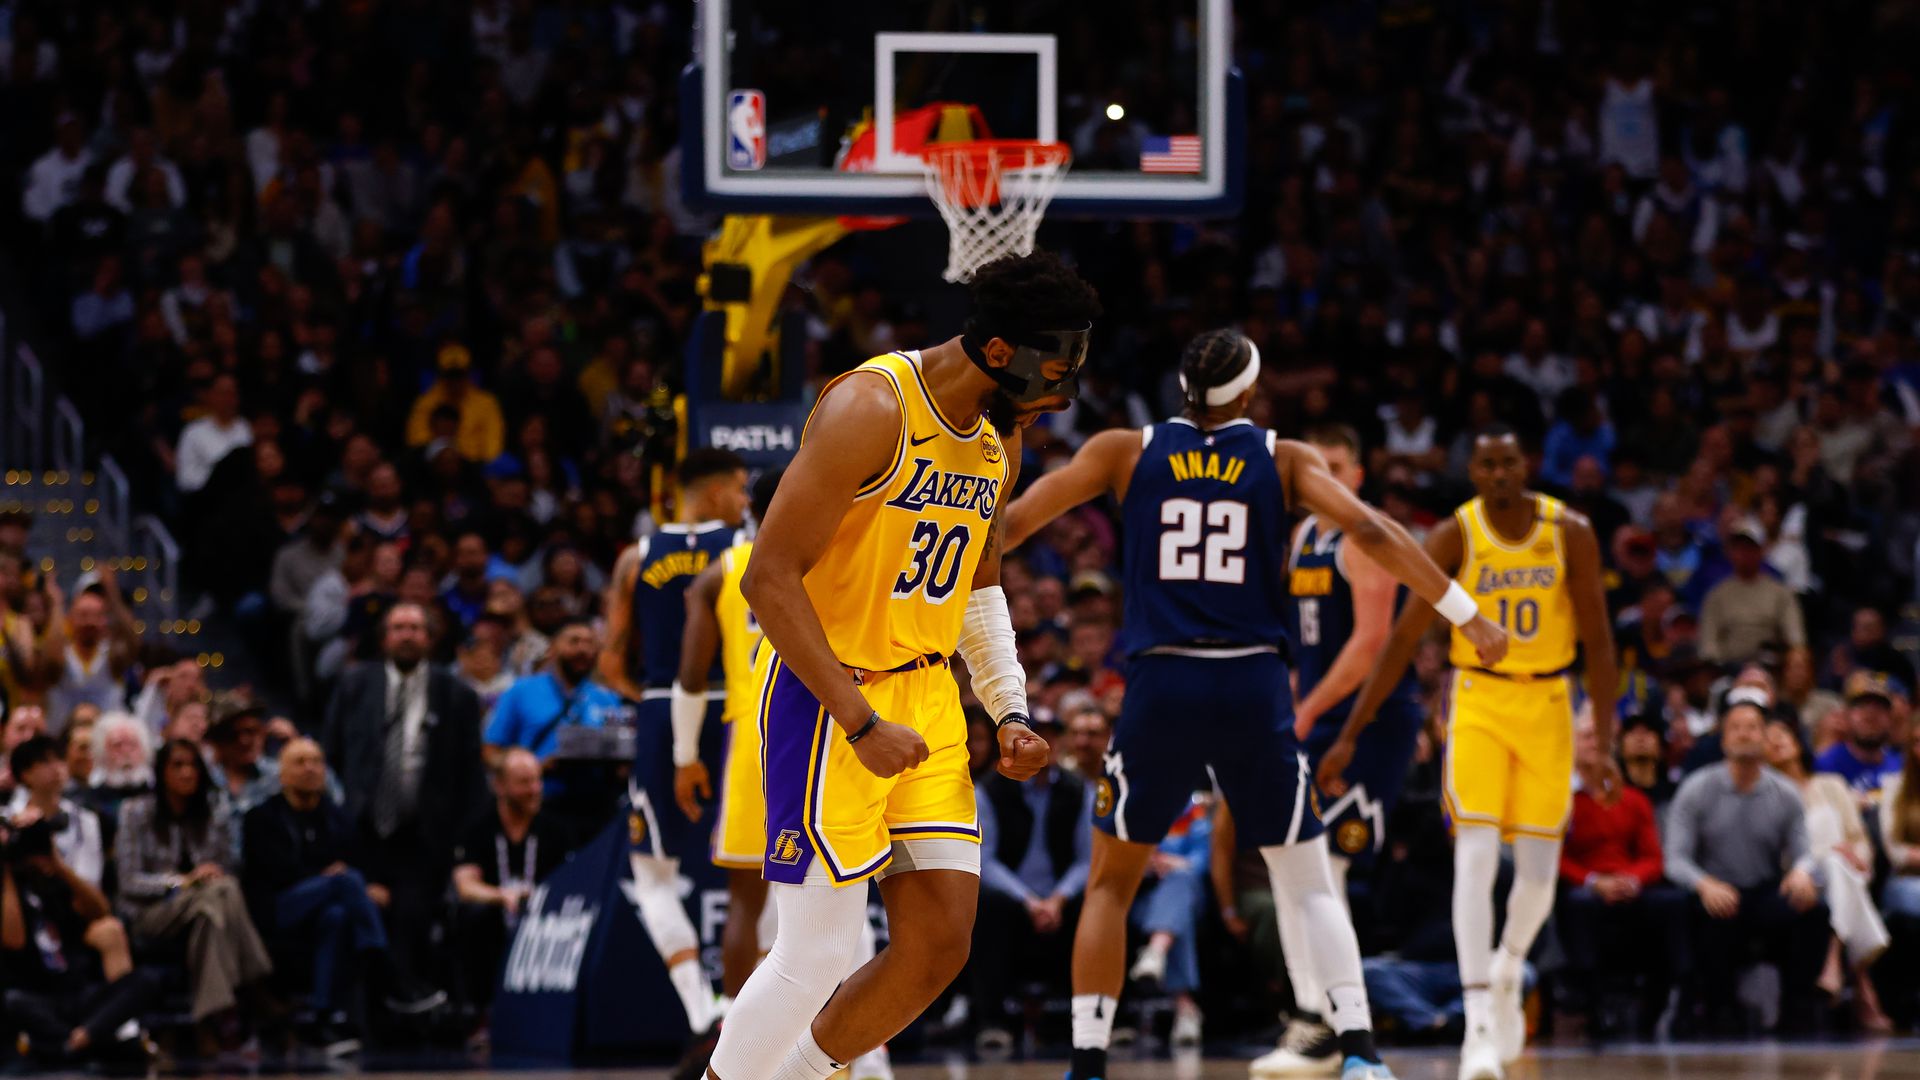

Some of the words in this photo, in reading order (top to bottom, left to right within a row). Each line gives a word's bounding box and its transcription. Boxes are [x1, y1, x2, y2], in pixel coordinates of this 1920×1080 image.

[710, 425, 794, 451] PATH
[885, 457, 999, 520] LAKERS
[1168, 450, 1246, 485] NNAJI
[891, 519, 971, 605] 30
[1159, 497, 1249, 584] 22
[1475, 564, 1556, 594] LAKERS
[1498, 597, 1540, 642] 10
